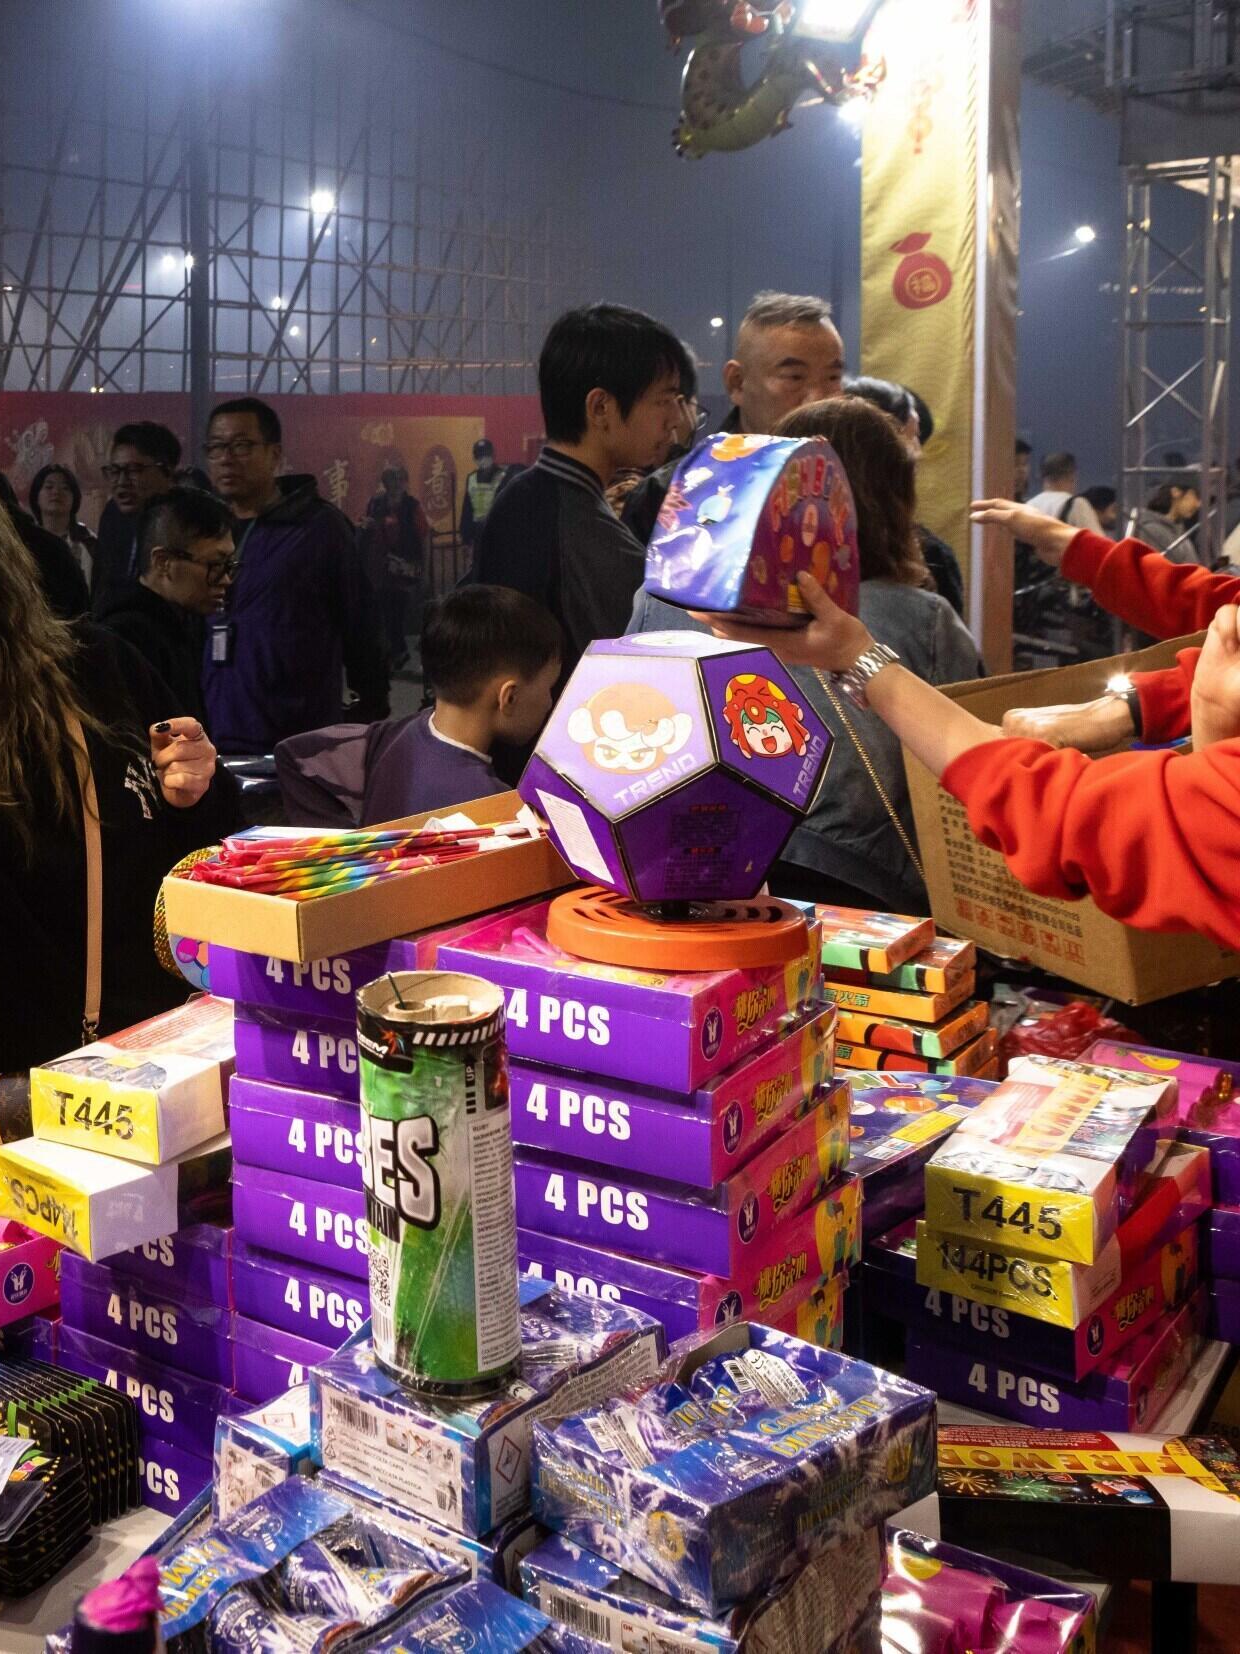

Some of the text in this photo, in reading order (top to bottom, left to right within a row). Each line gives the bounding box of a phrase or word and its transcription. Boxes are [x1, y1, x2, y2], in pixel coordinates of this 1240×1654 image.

[614, 753, 697, 808] TREND
[792, 735, 824, 798] TREND
[266, 956, 351, 995] 4 PCS
[507, 987, 610, 1046] 4 PCS
[292, 1031, 357, 1073] 4 PC
[53, 1093, 135, 1140] T445
[527, 1083, 630, 1140] 4 PCS
[289, 1118, 364, 1166] 4 PCS
[545, 1174, 648, 1230] 4 PCS
[953, 1186, 1062, 1240] T445
[127, 1236, 176, 1267] CS
[290, 1209, 367, 1255] 4 PCS
[108, 1294, 178, 1345] 4 PCS
[285, 1277, 364, 1334] 4 PCS
[924, 1288, 943, 1317] 4
[952, 1300, 1010, 1338] PCS
[968, 1363, 1061, 1414] 4 PCS
[938, 1448, 1187, 1476] FIREWOR
